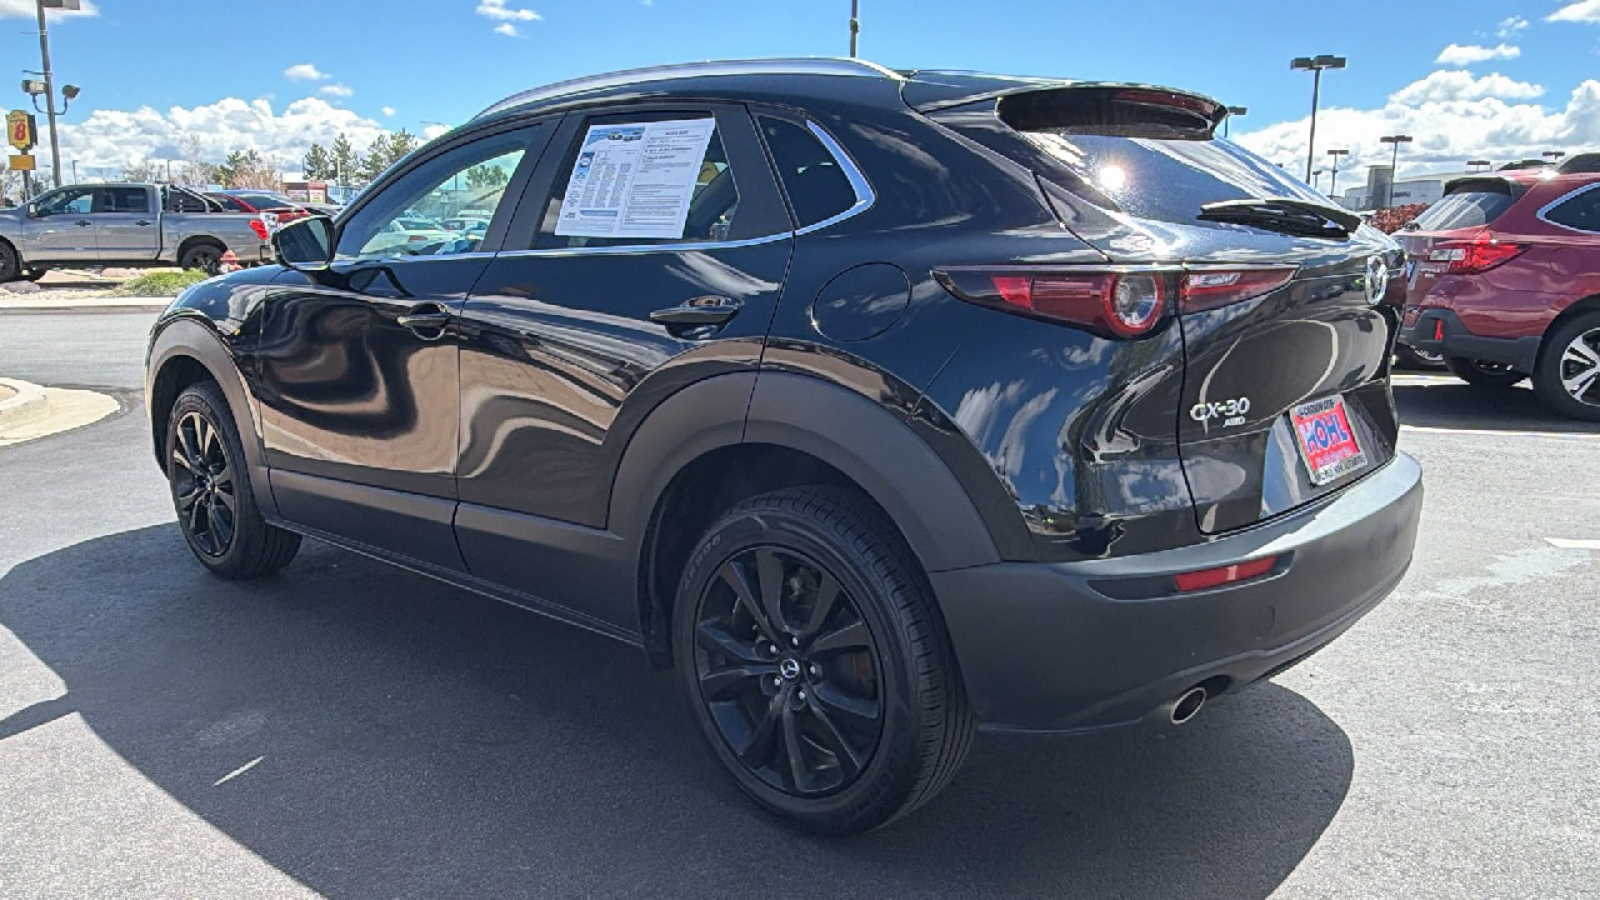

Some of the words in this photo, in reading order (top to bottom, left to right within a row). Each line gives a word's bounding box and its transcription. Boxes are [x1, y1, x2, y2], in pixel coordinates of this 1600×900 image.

[14, 122, 26, 141] 8
[1190, 397, 1250, 421] CX-30
[1299, 412, 1349, 454] HOHL
